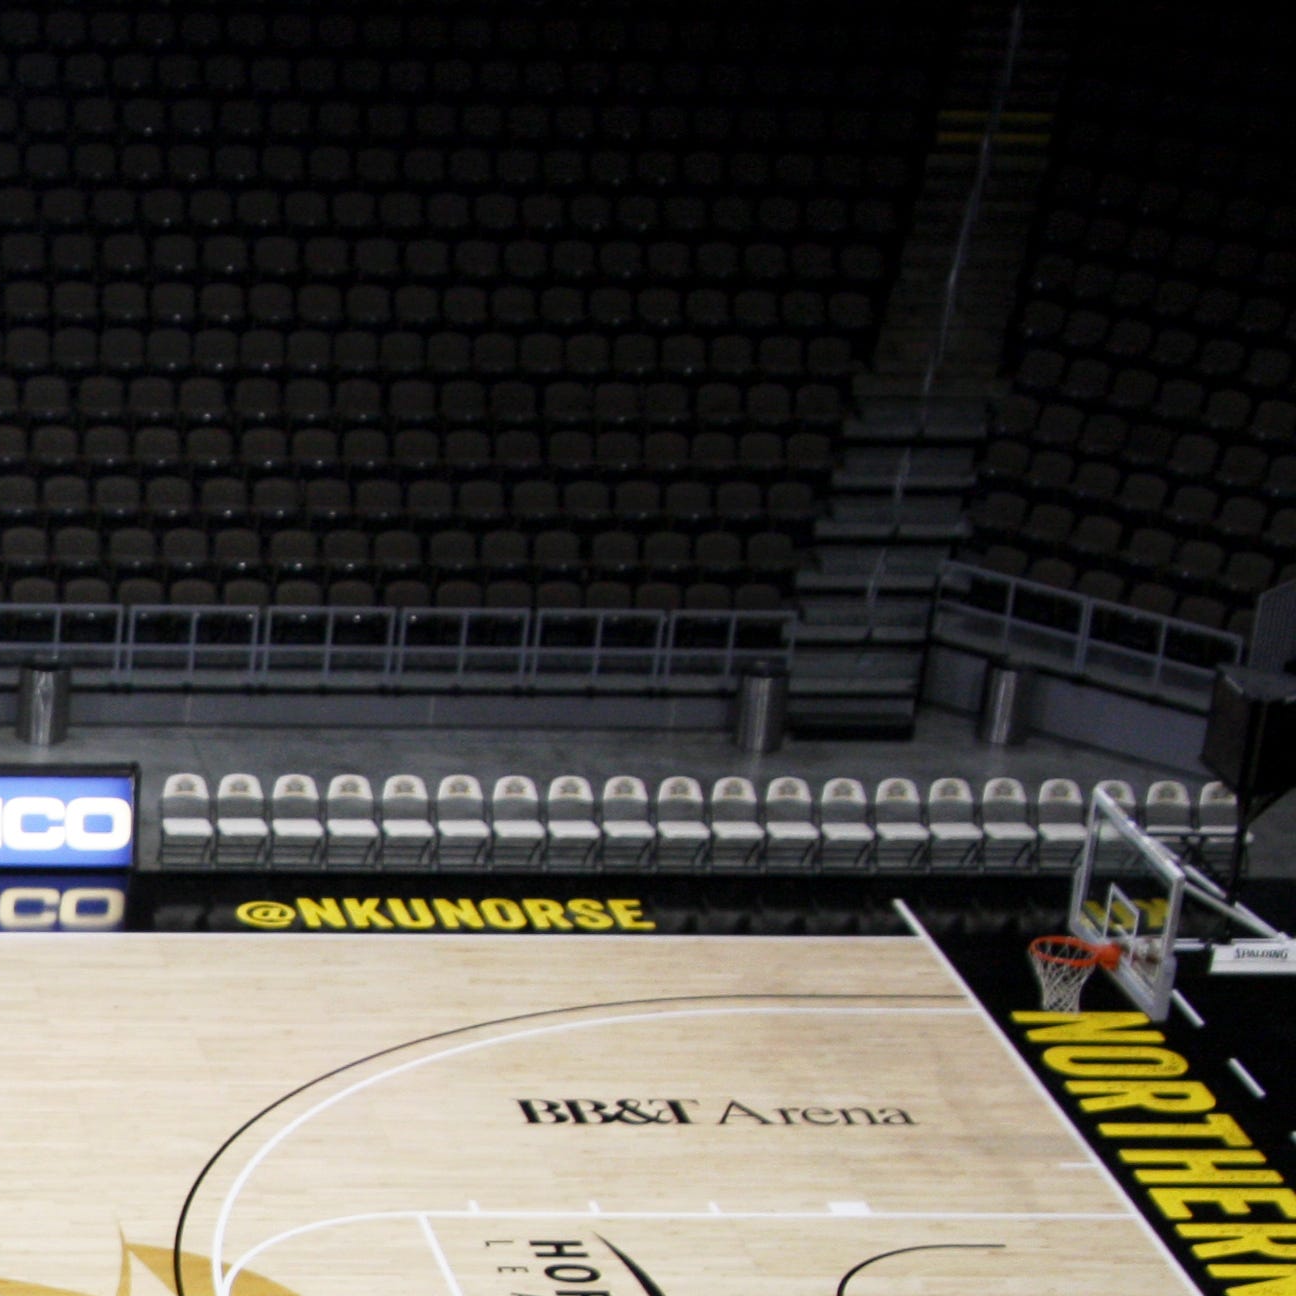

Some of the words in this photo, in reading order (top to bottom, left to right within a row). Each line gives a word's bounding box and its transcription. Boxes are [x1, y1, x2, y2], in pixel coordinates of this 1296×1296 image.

[235, 897, 656, 930] @NKUNORSE
[512, 1098, 700, 1126] BB&T
[717, 1098, 922, 1126] Arena
